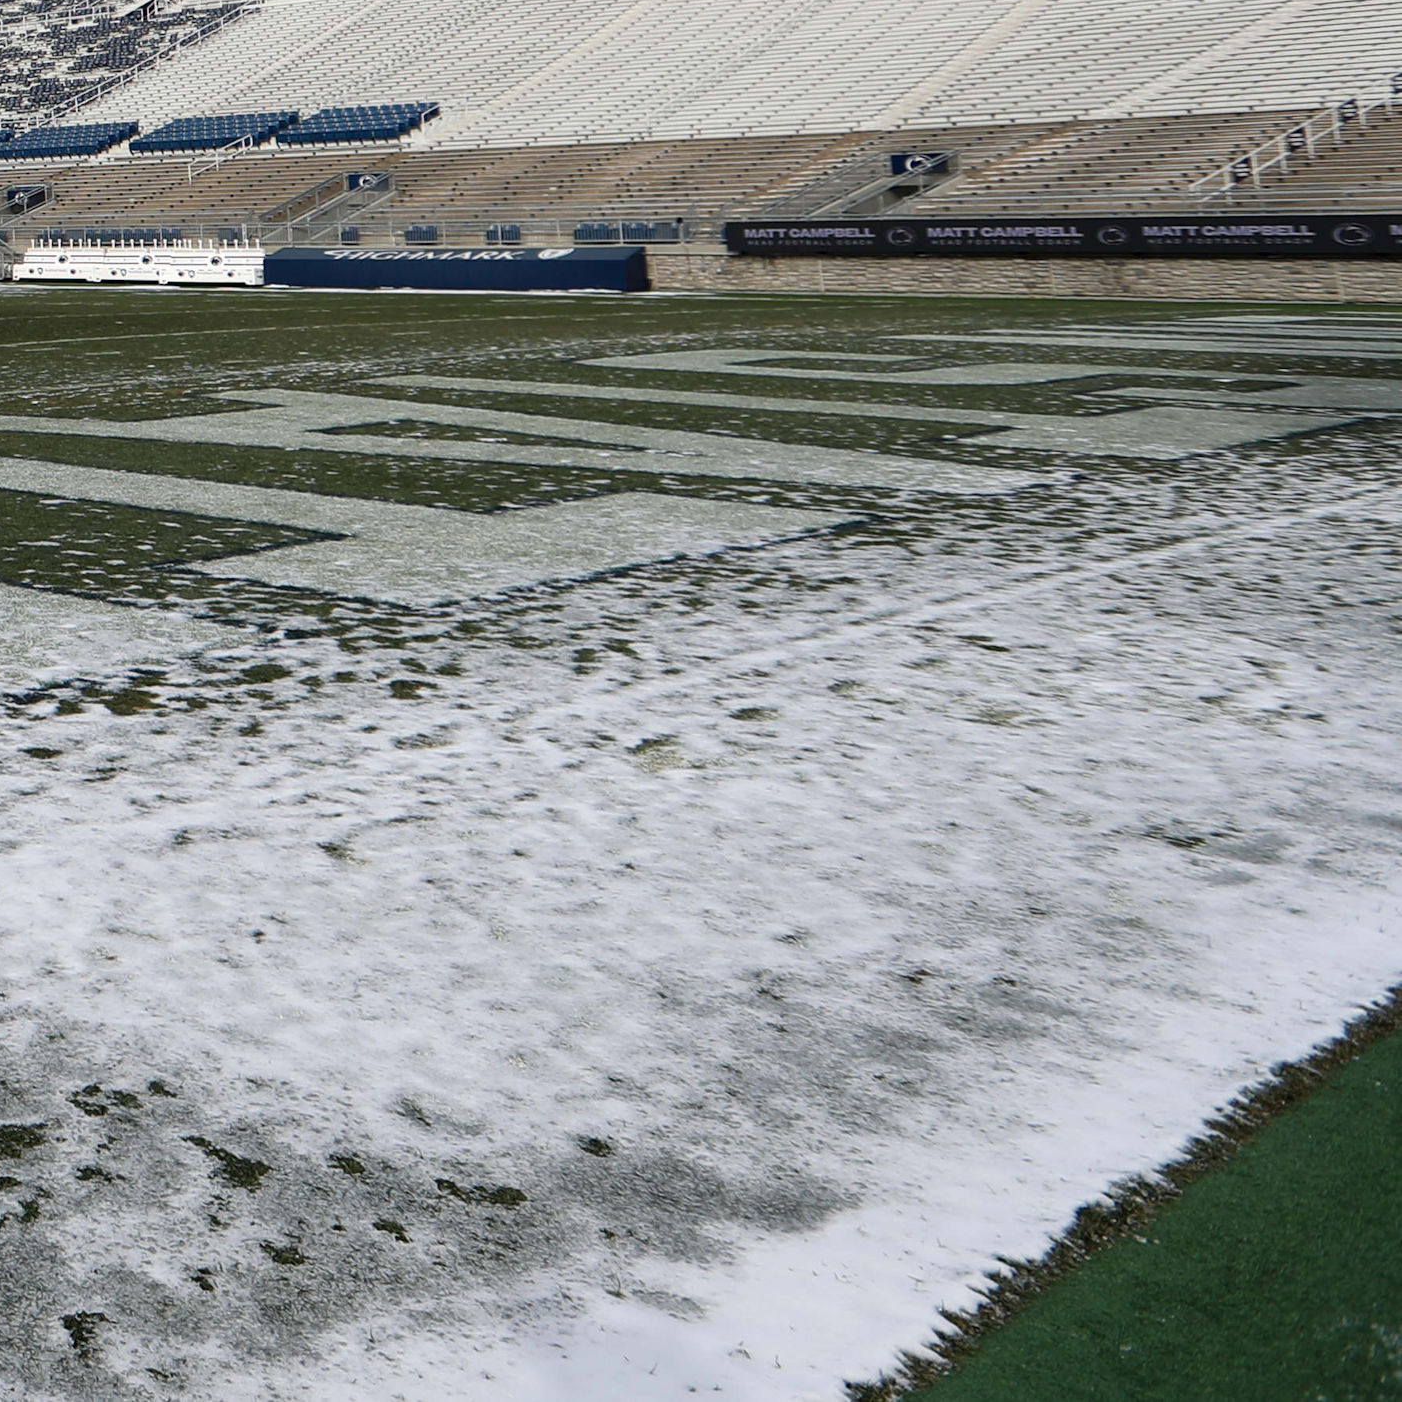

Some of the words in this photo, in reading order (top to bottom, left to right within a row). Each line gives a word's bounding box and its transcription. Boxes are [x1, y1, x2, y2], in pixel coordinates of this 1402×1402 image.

[744, 228, 788, 238] MATT
[789, 227, 876, 238] CAMPBELL
[927, 227, 979, 238] MATT
[981, 226, 1083, 238] CAMPBELL
[1142, 226, 1199, 237] MATT
[1201, 225, 1316, 236] CAMPBELL
[323, 249, 524, 260] HIGHMARK
